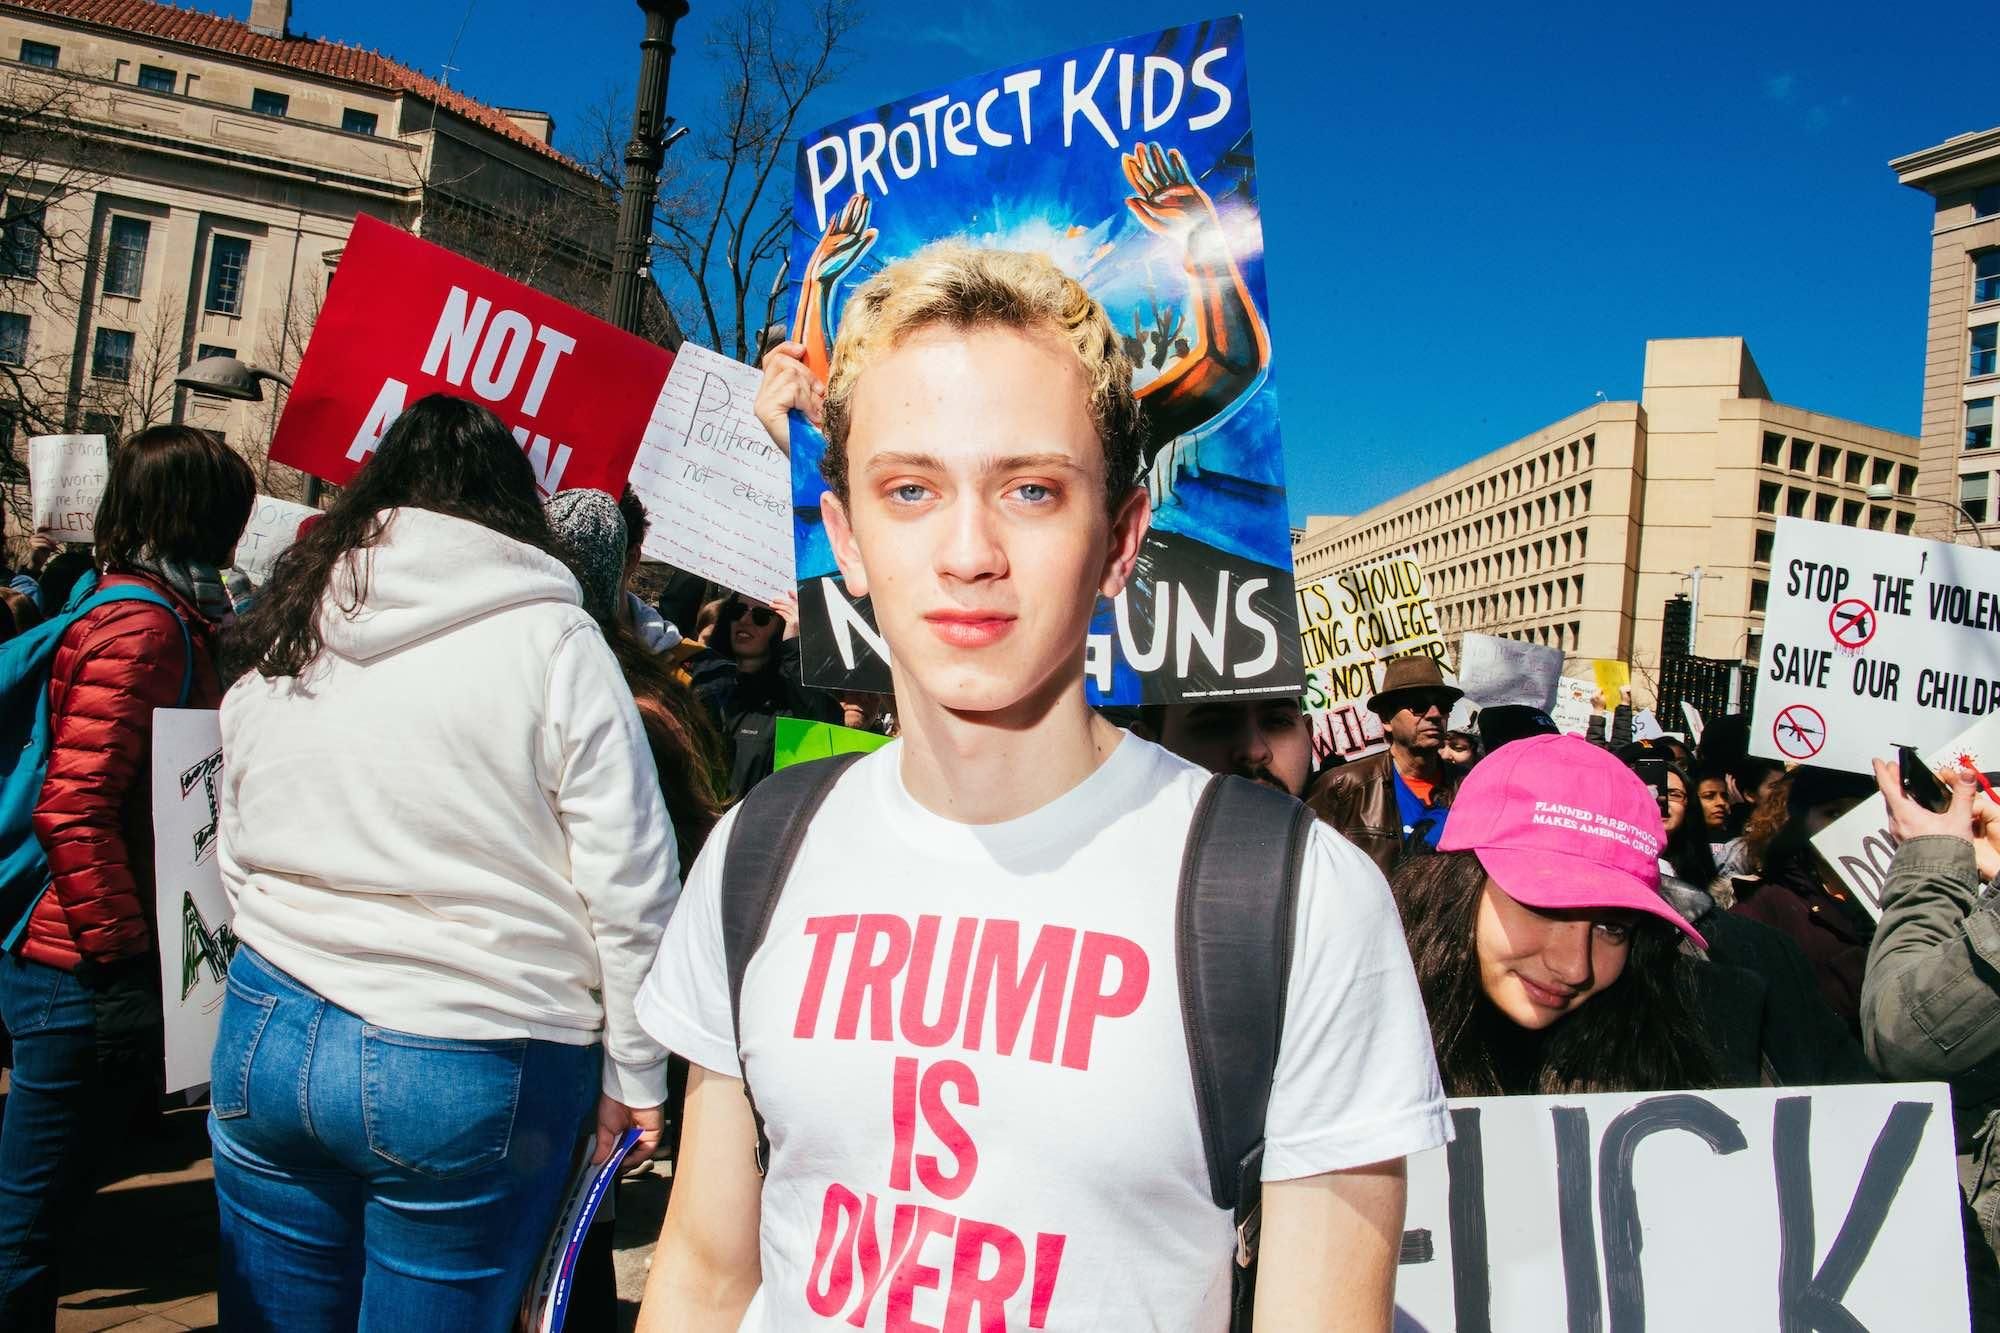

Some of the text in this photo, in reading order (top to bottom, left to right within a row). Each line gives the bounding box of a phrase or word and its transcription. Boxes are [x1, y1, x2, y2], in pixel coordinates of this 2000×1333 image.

[1063, 47, 1232, 149] KIDS
[420, 285, 577, 418] NOT
[683, 464, 715, 485] not
[1338, 561, 1421, 614] SHOULD
[1787, 559, 1850, 604] STOP
[1872, 573, 1914, 616] THE
[1356, 599, 1437, 651] COLLEGE
[1332, 661, 1377, 701] NOT
[1770, 643, 1832, 688] SAVE
[1852, 658, 1900, 702] OUR
[1533, 814, 1578, 830] MAKES
[1579, 824, 1631, 846] AMERICA
[1535, 801, 1593, 821] PLANNED
[793, 913, 1150, 1071] TRUMP
[889, 1056, 980, 1200] IS
[1400, 1093, 1935, 1333] UCK
[806, 1183, 1067, 1333] OVER!
